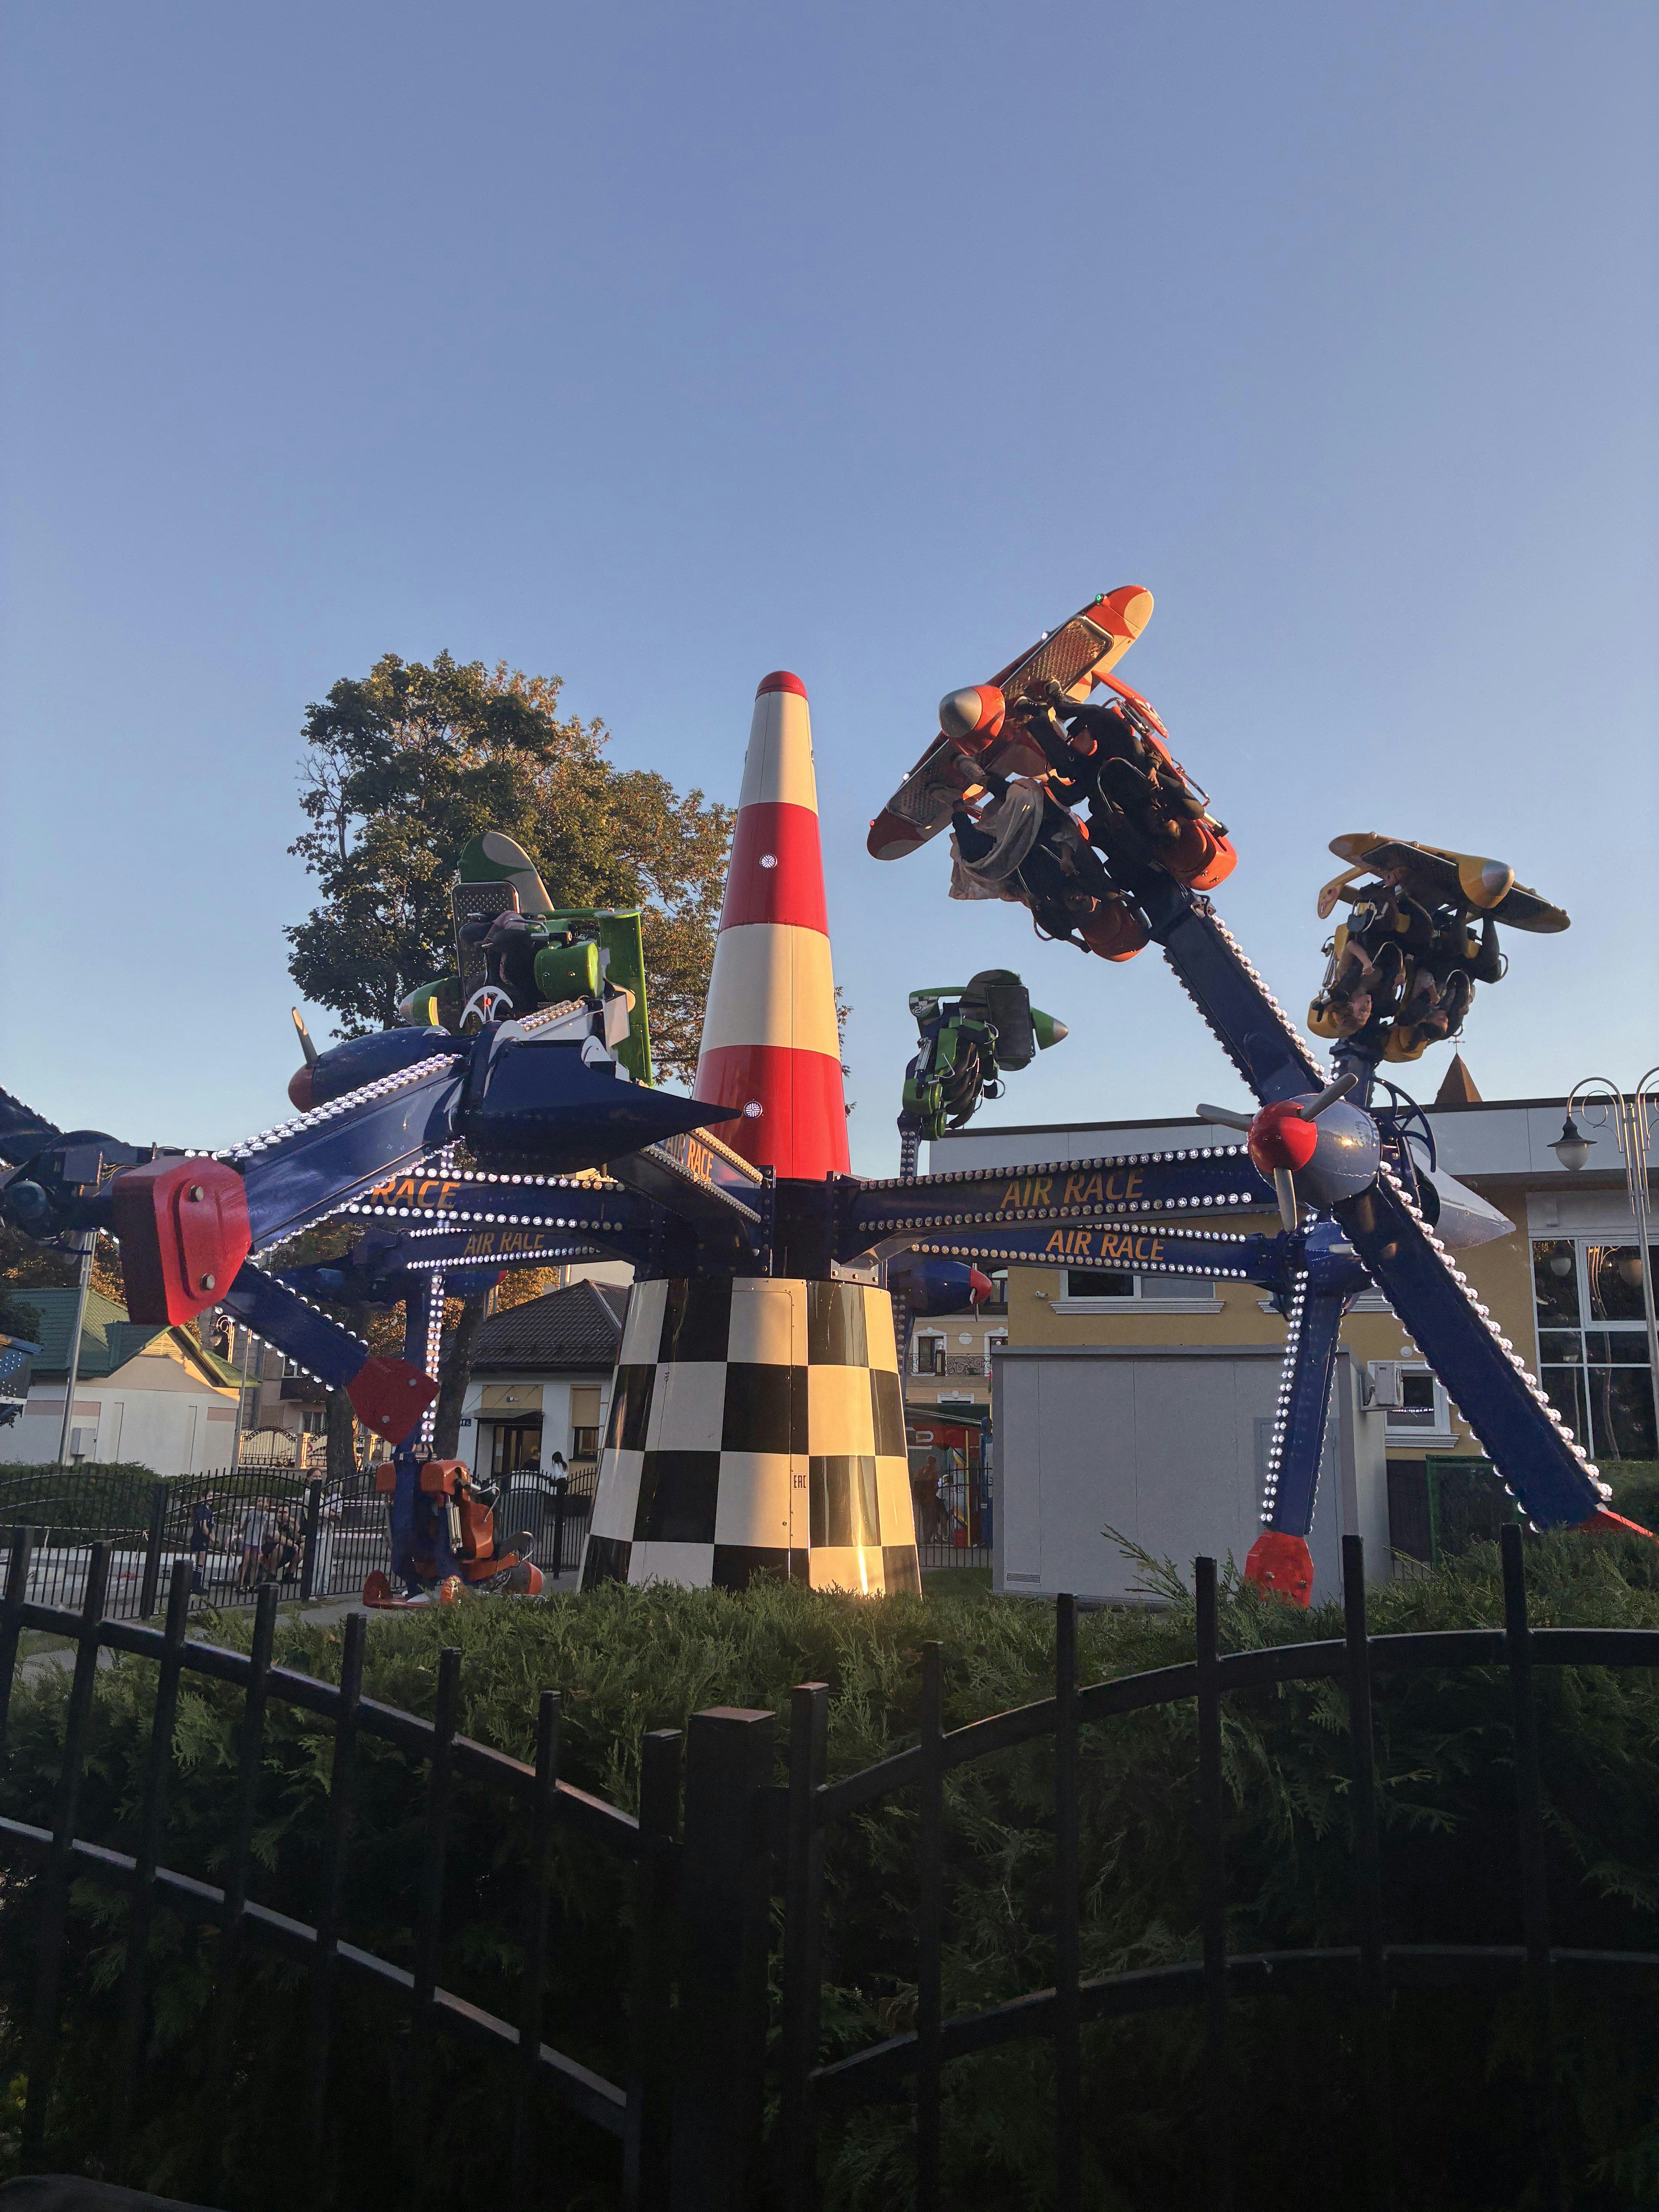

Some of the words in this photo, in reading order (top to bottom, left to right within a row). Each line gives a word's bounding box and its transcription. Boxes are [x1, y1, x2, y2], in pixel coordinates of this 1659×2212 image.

[665, 1133, 685, 1165] AIR
[687, 1138, 714, 1182] RACE
[371, 1179, 460, 1209] RACE
[1001, 1177, 1053, 1208] AIR
[1064, 1168, 1144, 1204] RACE
[464, 1232, 495, 1257] AIR
[1046, 1230, 1091, 1255] AIR
[1101, 1233, 1166, 1261] RACE
[794, 1475, 806, 1488] EAC
